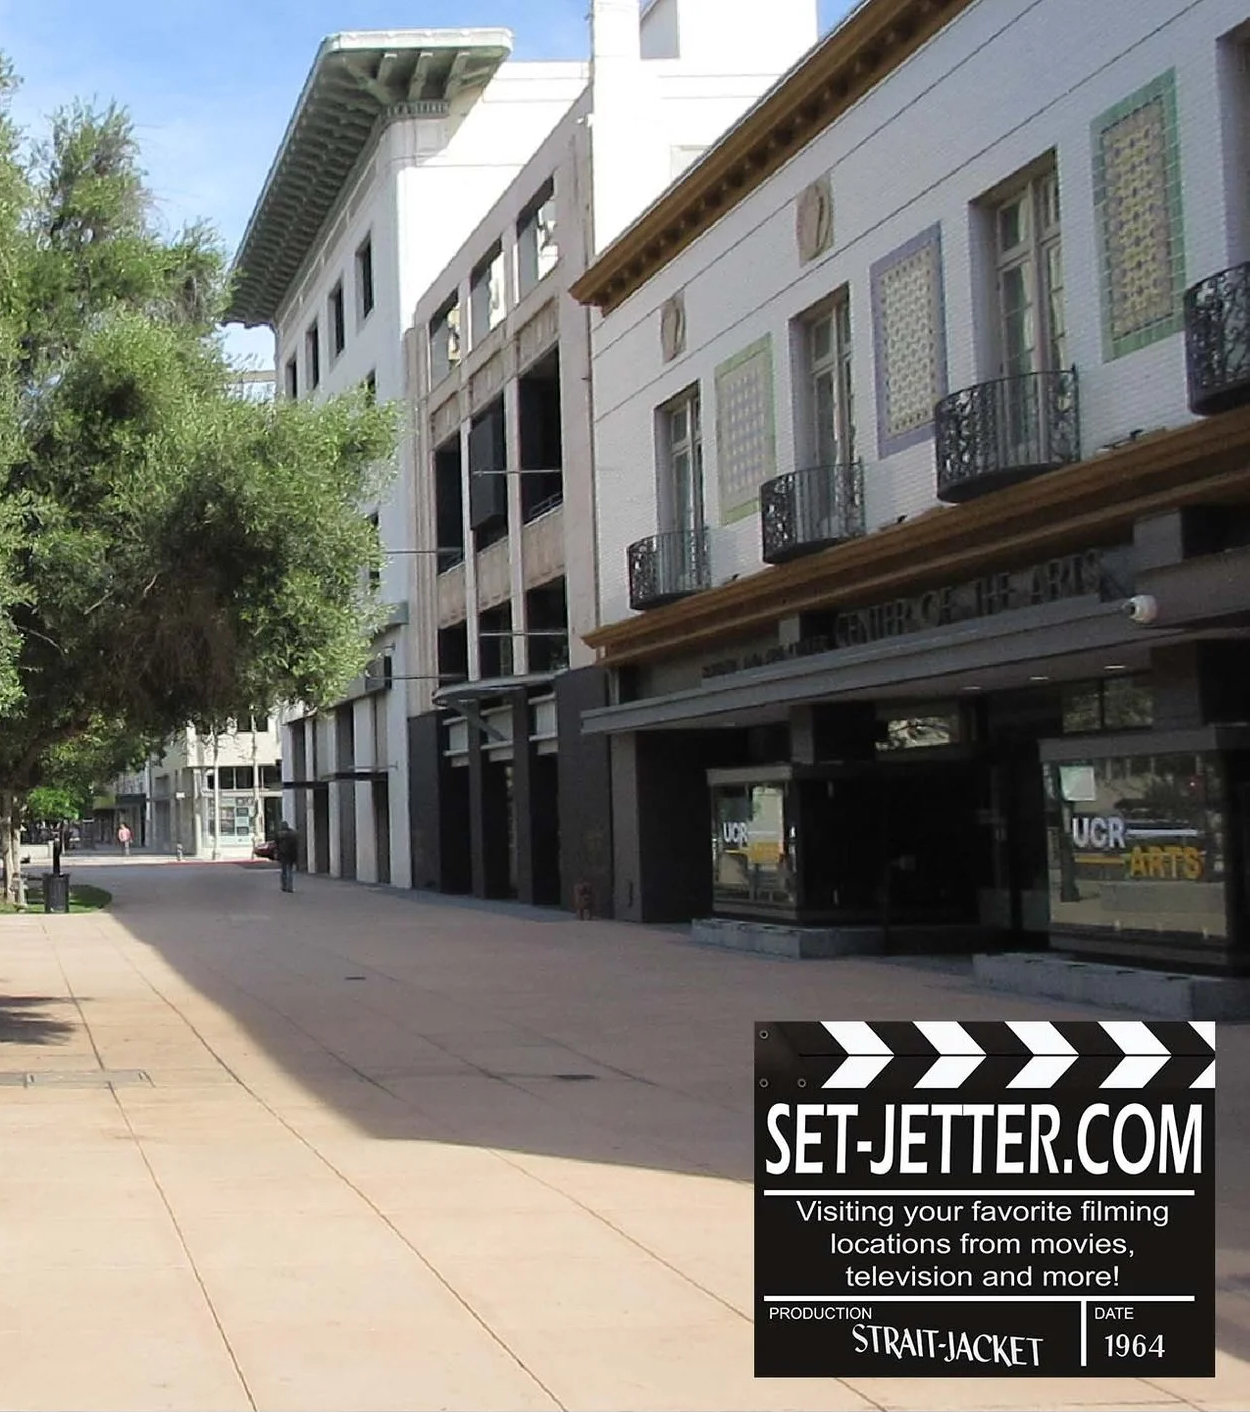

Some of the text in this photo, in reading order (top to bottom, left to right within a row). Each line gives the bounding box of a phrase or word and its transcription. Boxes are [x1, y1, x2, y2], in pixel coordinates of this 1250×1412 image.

[723, 821, 748, 844] UCR
[1072, 816, 1126, 849] UCR
[1129, 846, 1201, 879] ARTS
